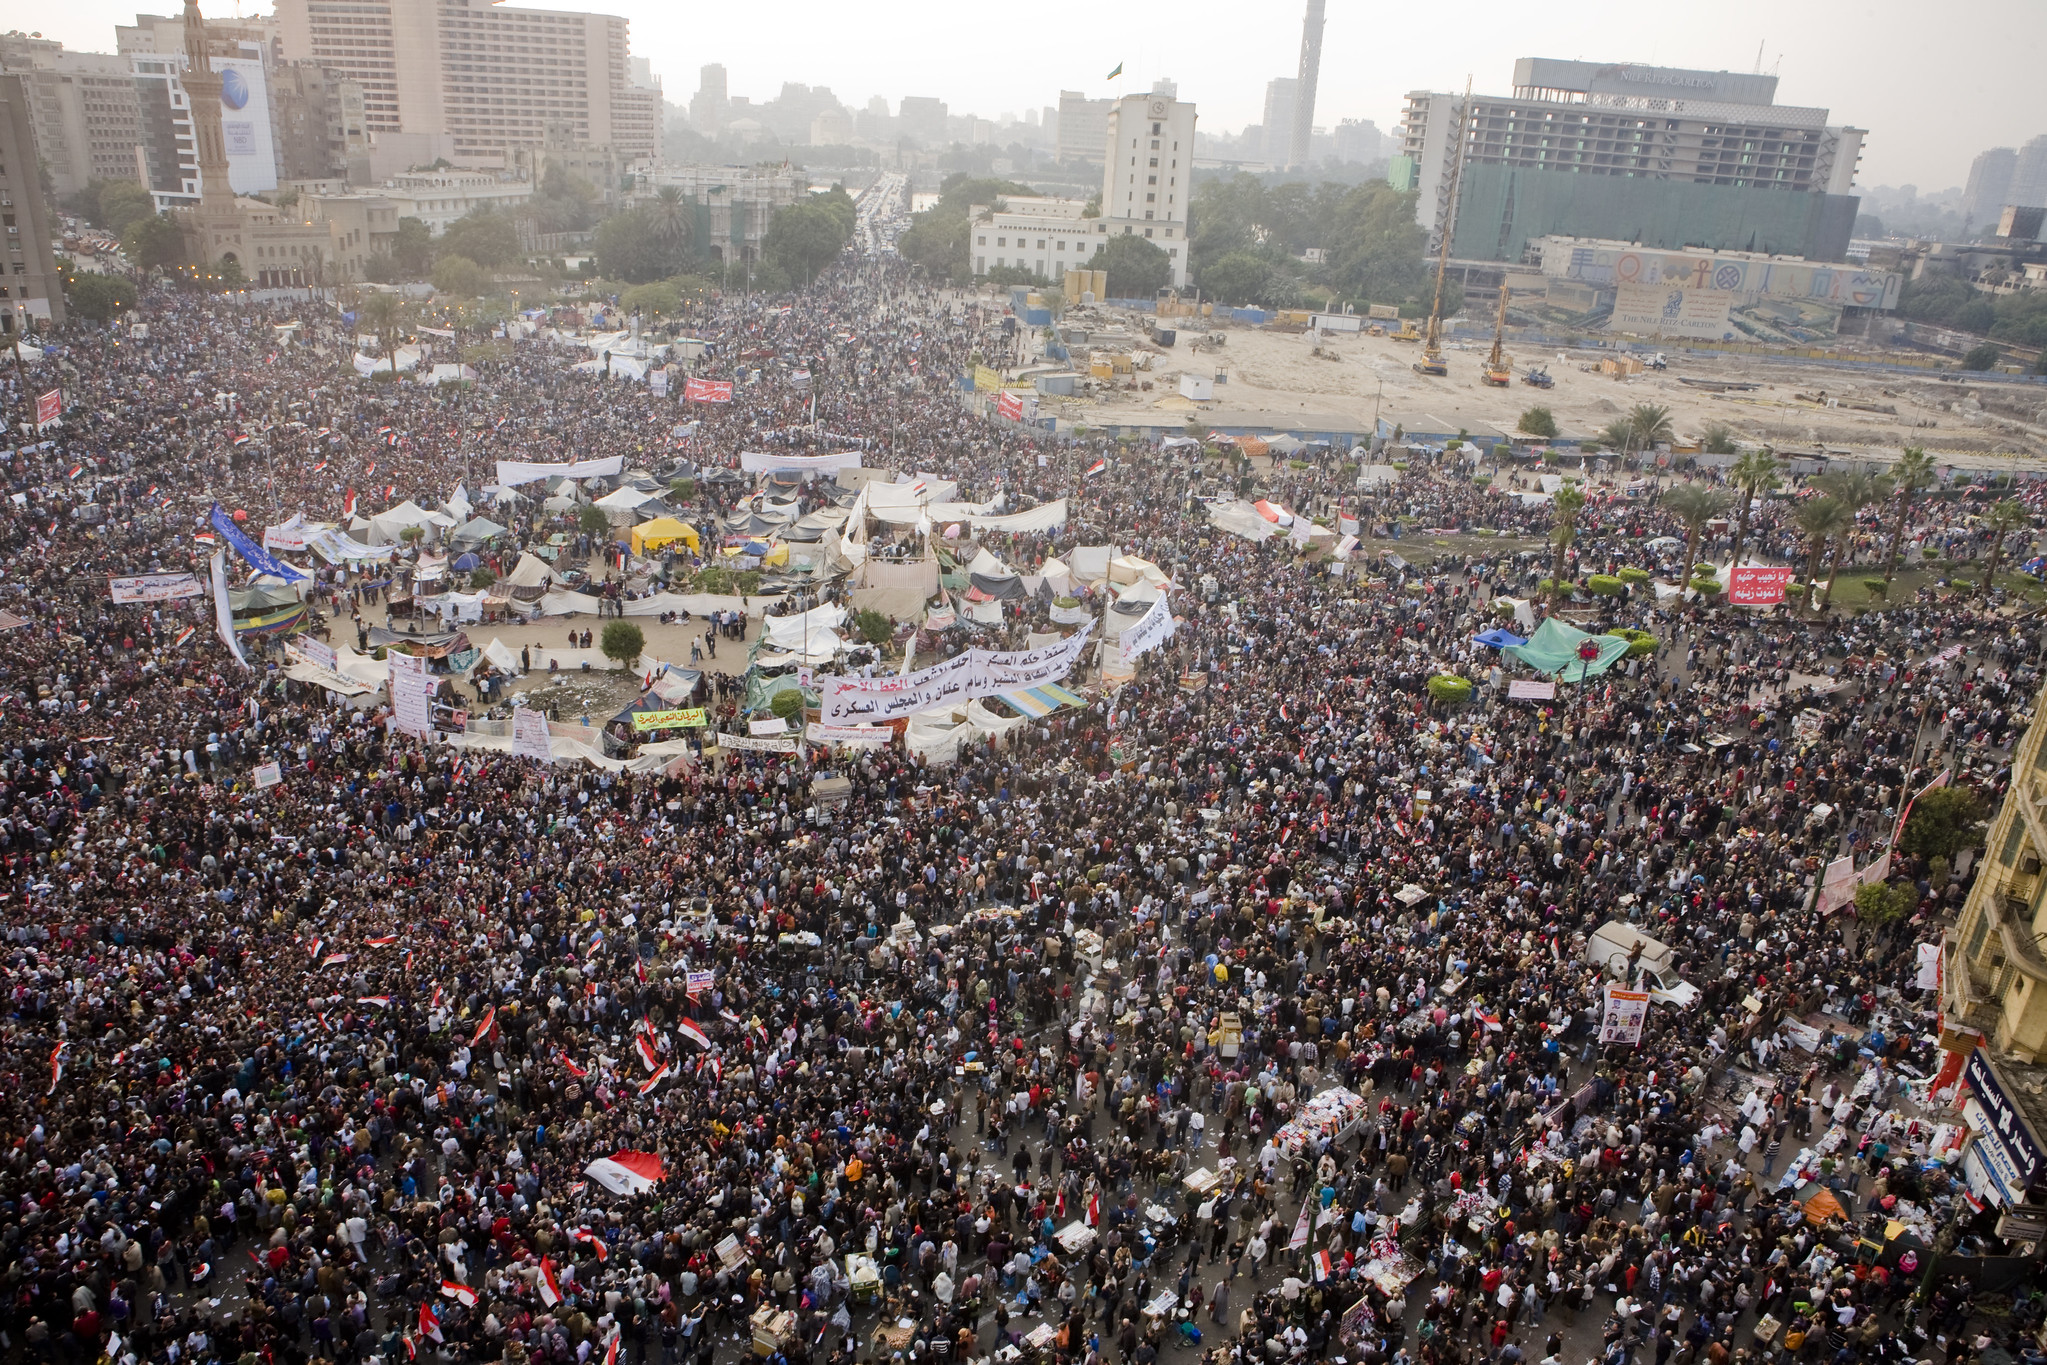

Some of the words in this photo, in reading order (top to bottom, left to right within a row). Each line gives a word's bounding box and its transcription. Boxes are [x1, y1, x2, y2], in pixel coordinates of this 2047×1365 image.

[1621, 71, 1640, 82] NILE
[1645, 71, 1714, 89] RITZ-CARLTON
[1640, 316, 1657, 324] NILE
[1019, 653, 1040, 668] حكم
[1971, 1055, 2002, 1111] للسياحة
